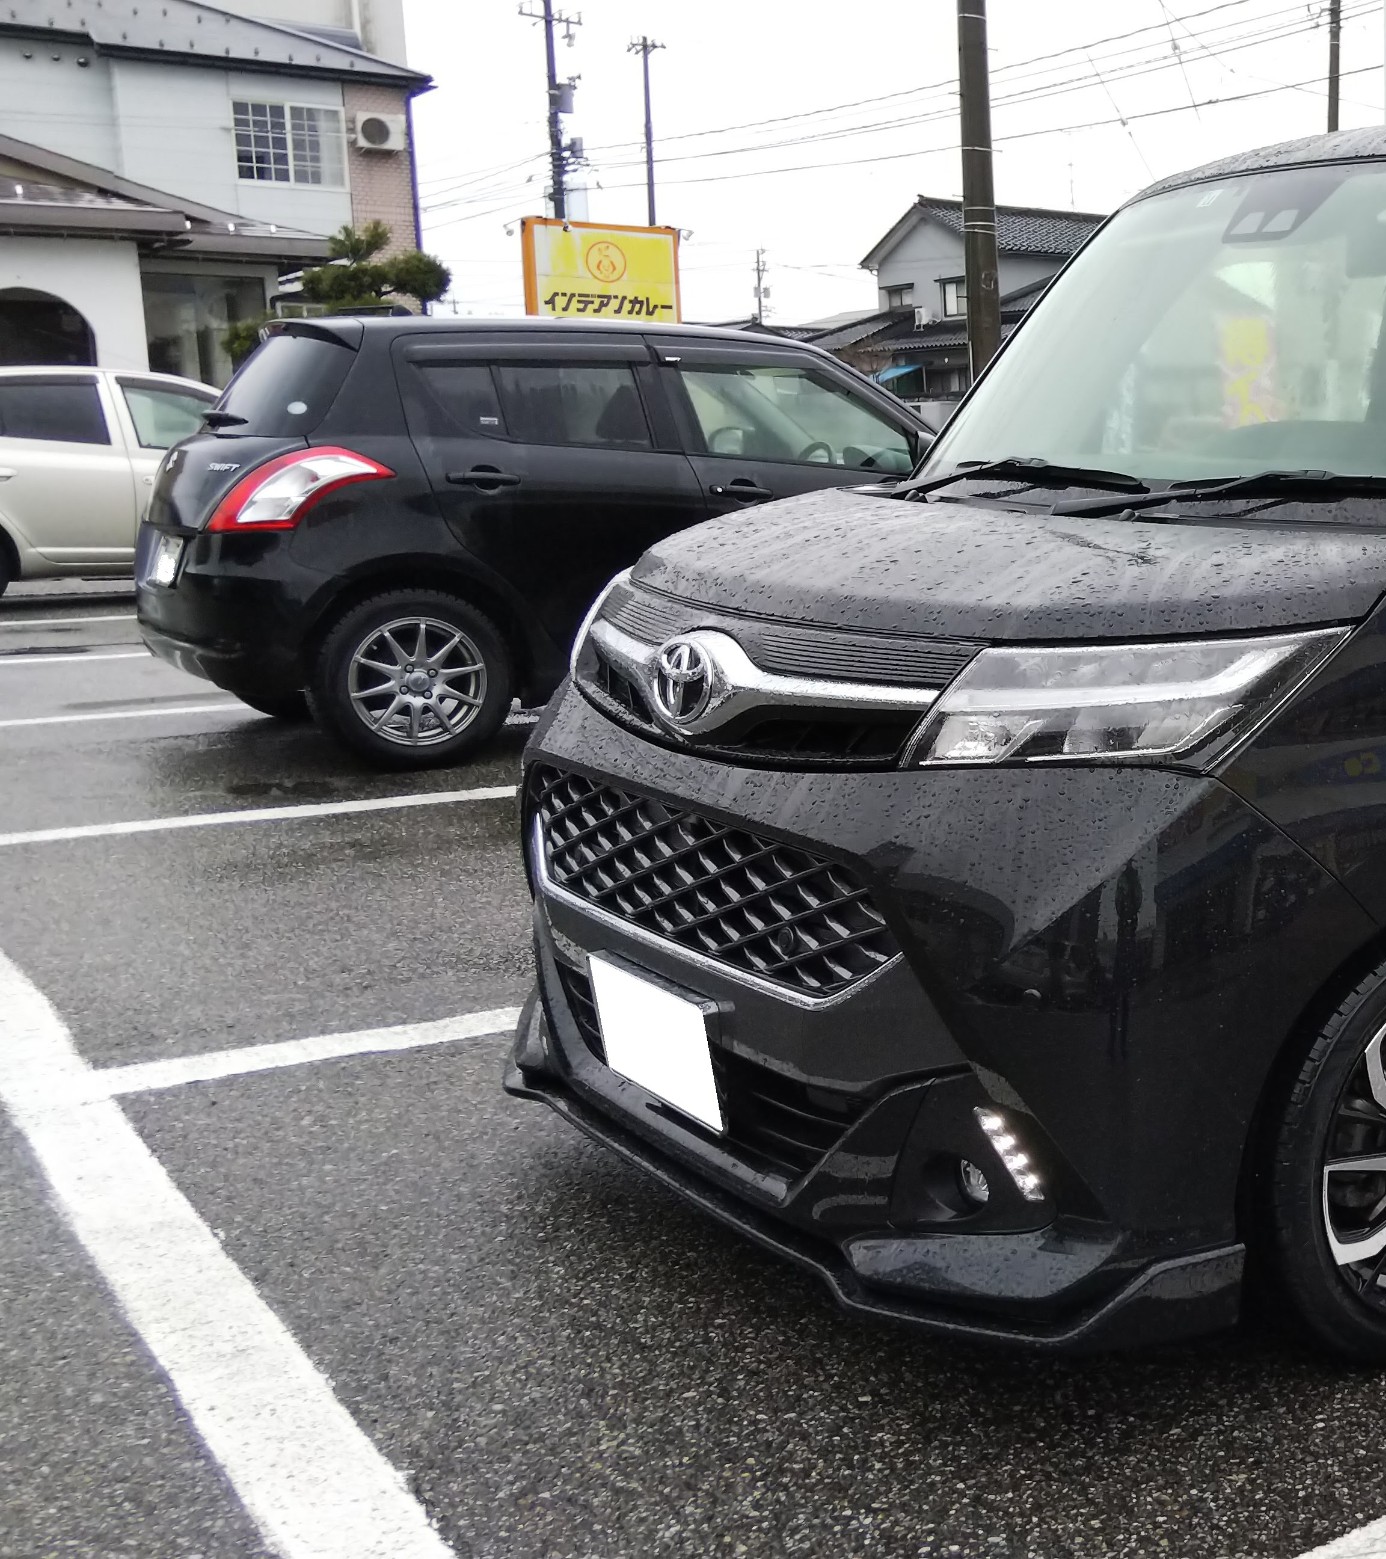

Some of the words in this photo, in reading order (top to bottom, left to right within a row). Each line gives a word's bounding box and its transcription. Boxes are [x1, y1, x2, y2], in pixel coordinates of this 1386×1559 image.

[544, 292, 673, 316] インデアンカレー
[208, 462, 241, 472] SWIFT
